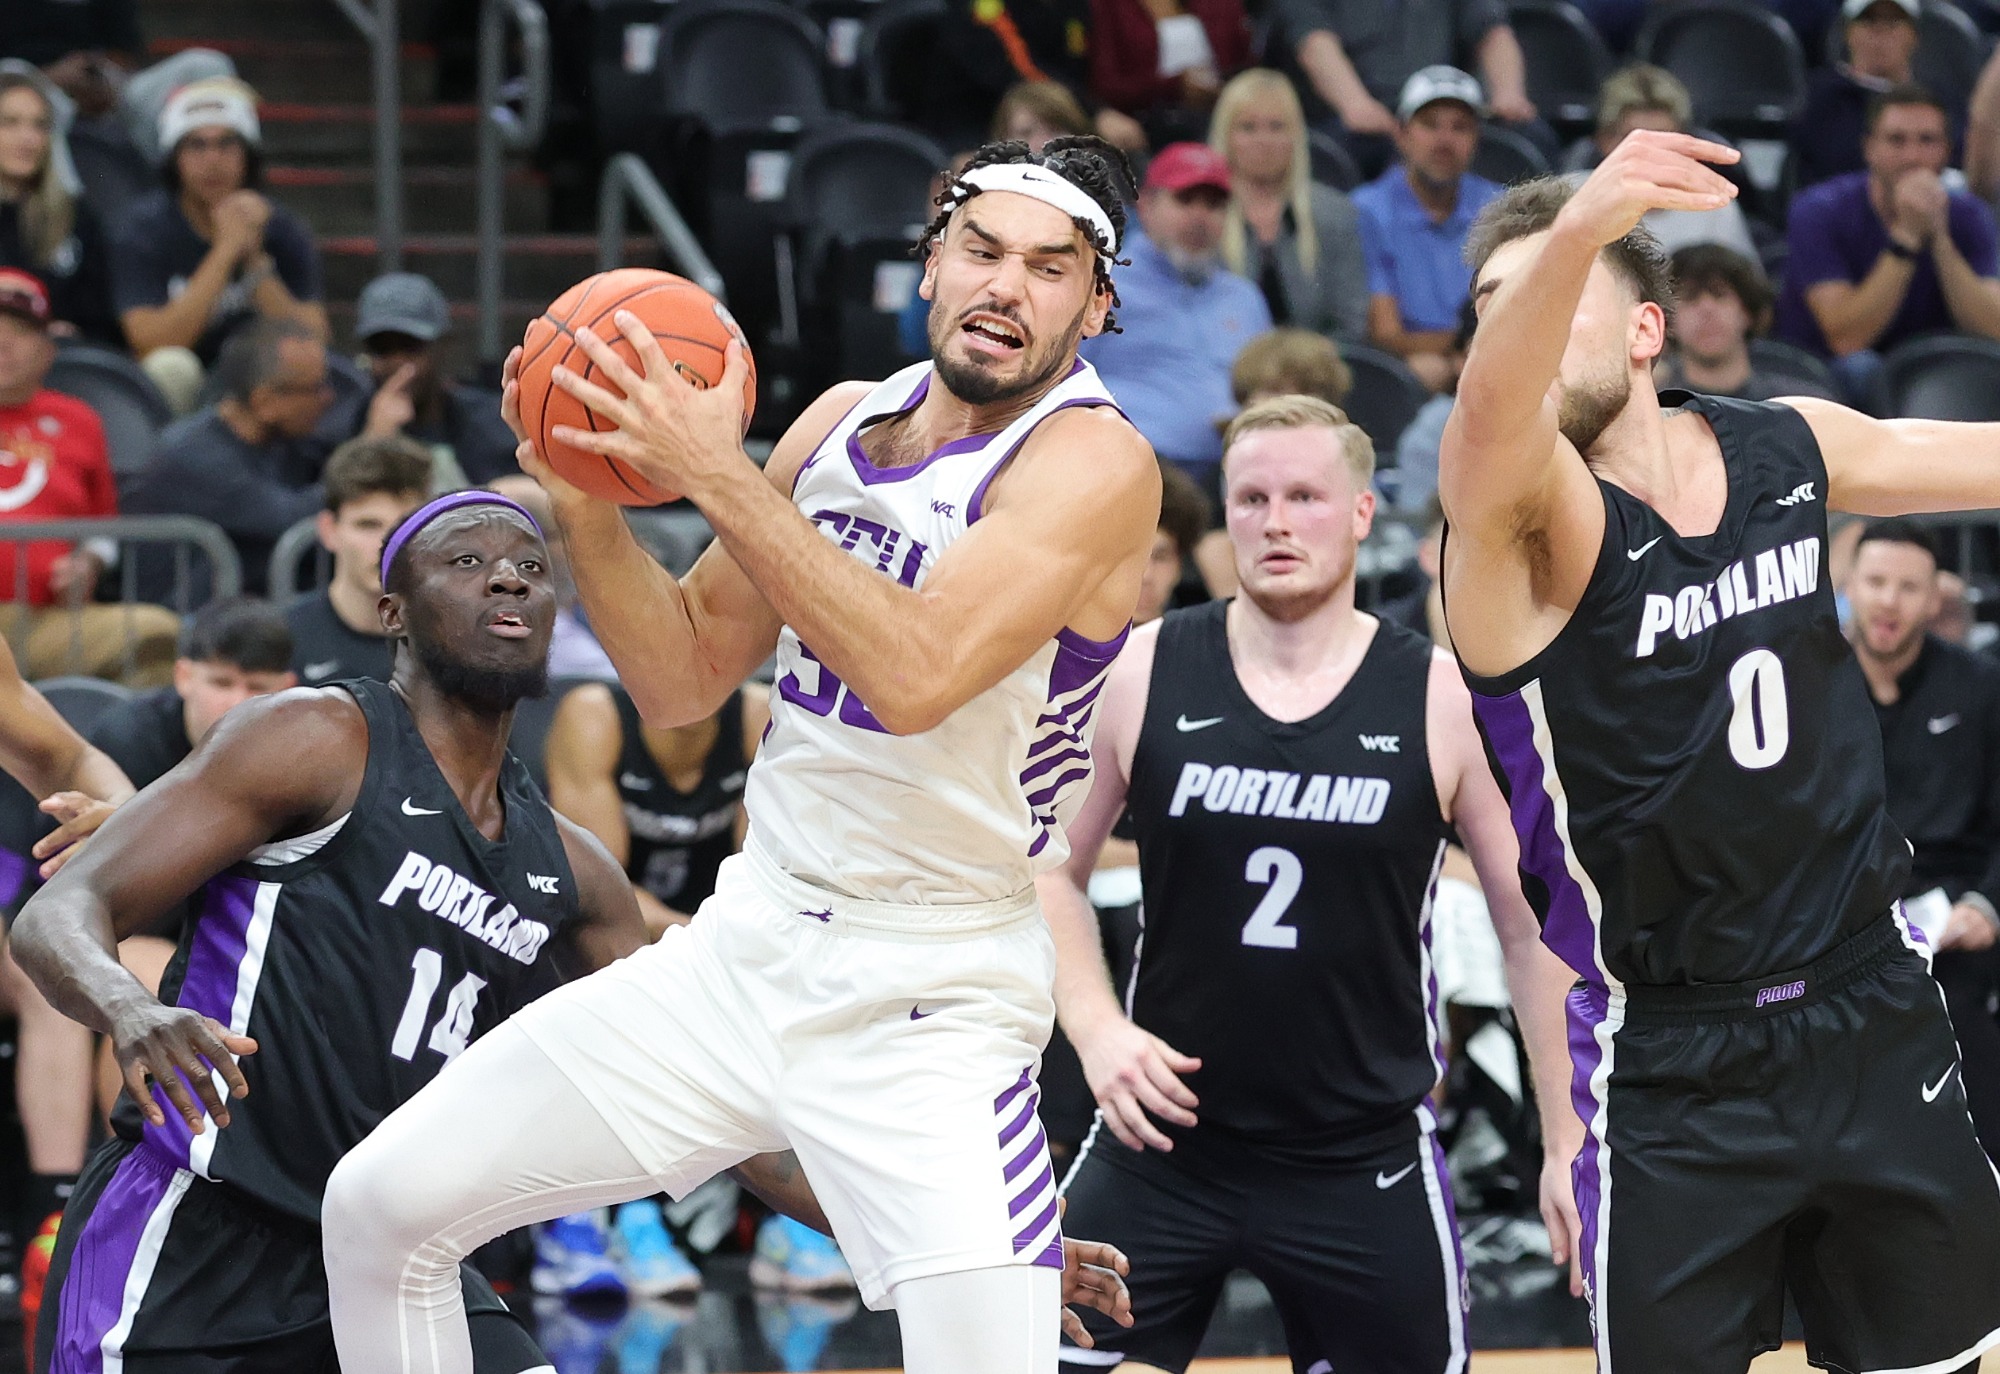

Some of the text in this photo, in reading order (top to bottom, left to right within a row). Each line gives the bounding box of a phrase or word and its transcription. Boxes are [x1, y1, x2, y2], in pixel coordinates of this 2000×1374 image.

[1357, 733, 1400, 752] WCC
[1727, 648, 1790, 770] 0
[1168, 761, 1392, 825] PORTLAND
[378, 851, 551, 966] PORTLAND
[526, 872, 560, 894] WCC
[1241, 846, 1304, 949] 2
[391, 947, 489, 1075] 14
[1755, 980, 1806, 1008] PILOTS
